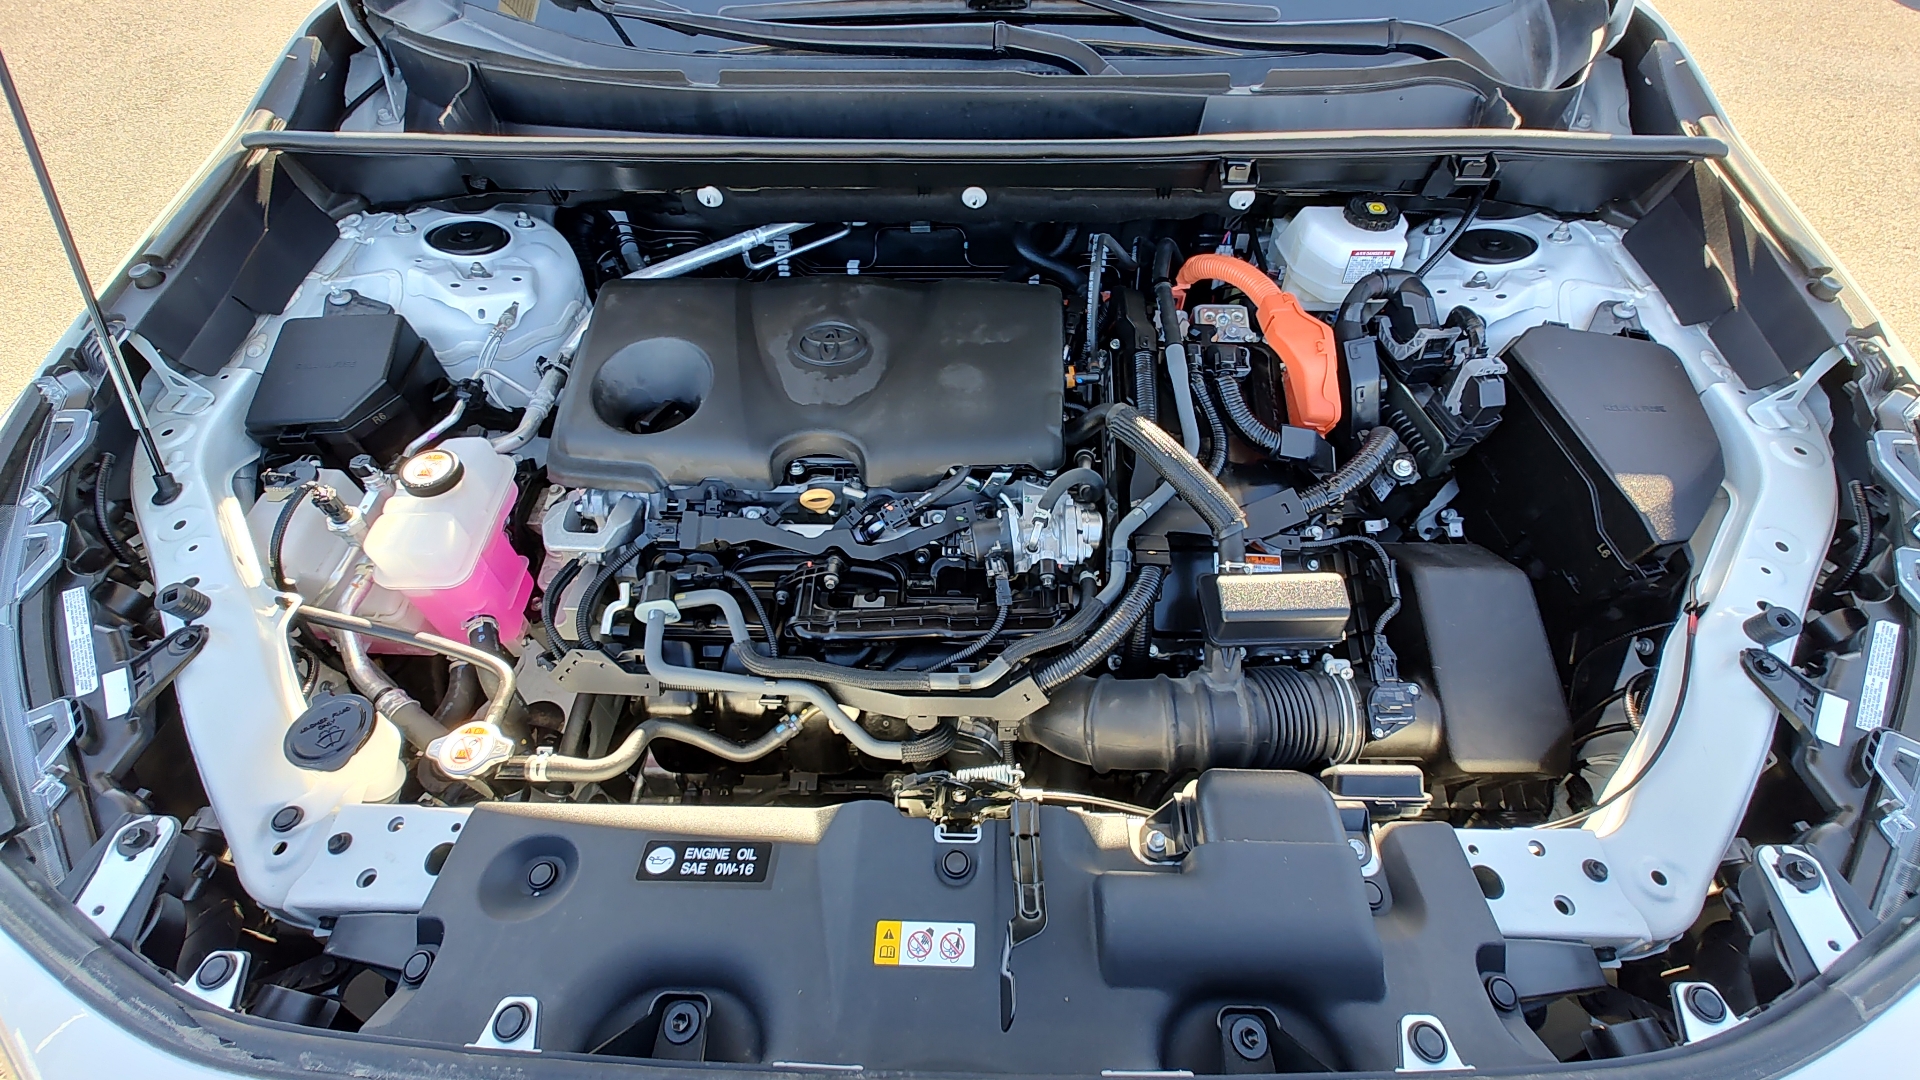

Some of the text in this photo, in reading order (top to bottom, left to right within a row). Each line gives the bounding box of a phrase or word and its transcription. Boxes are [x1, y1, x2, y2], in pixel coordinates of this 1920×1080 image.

[371, 412, 387, 425] R6
[1596, 543, 1611, 558] L6
[684, 847, 757, 860] ENGINE OIL
[680, 861, 754, 876] SAE 0W-16
